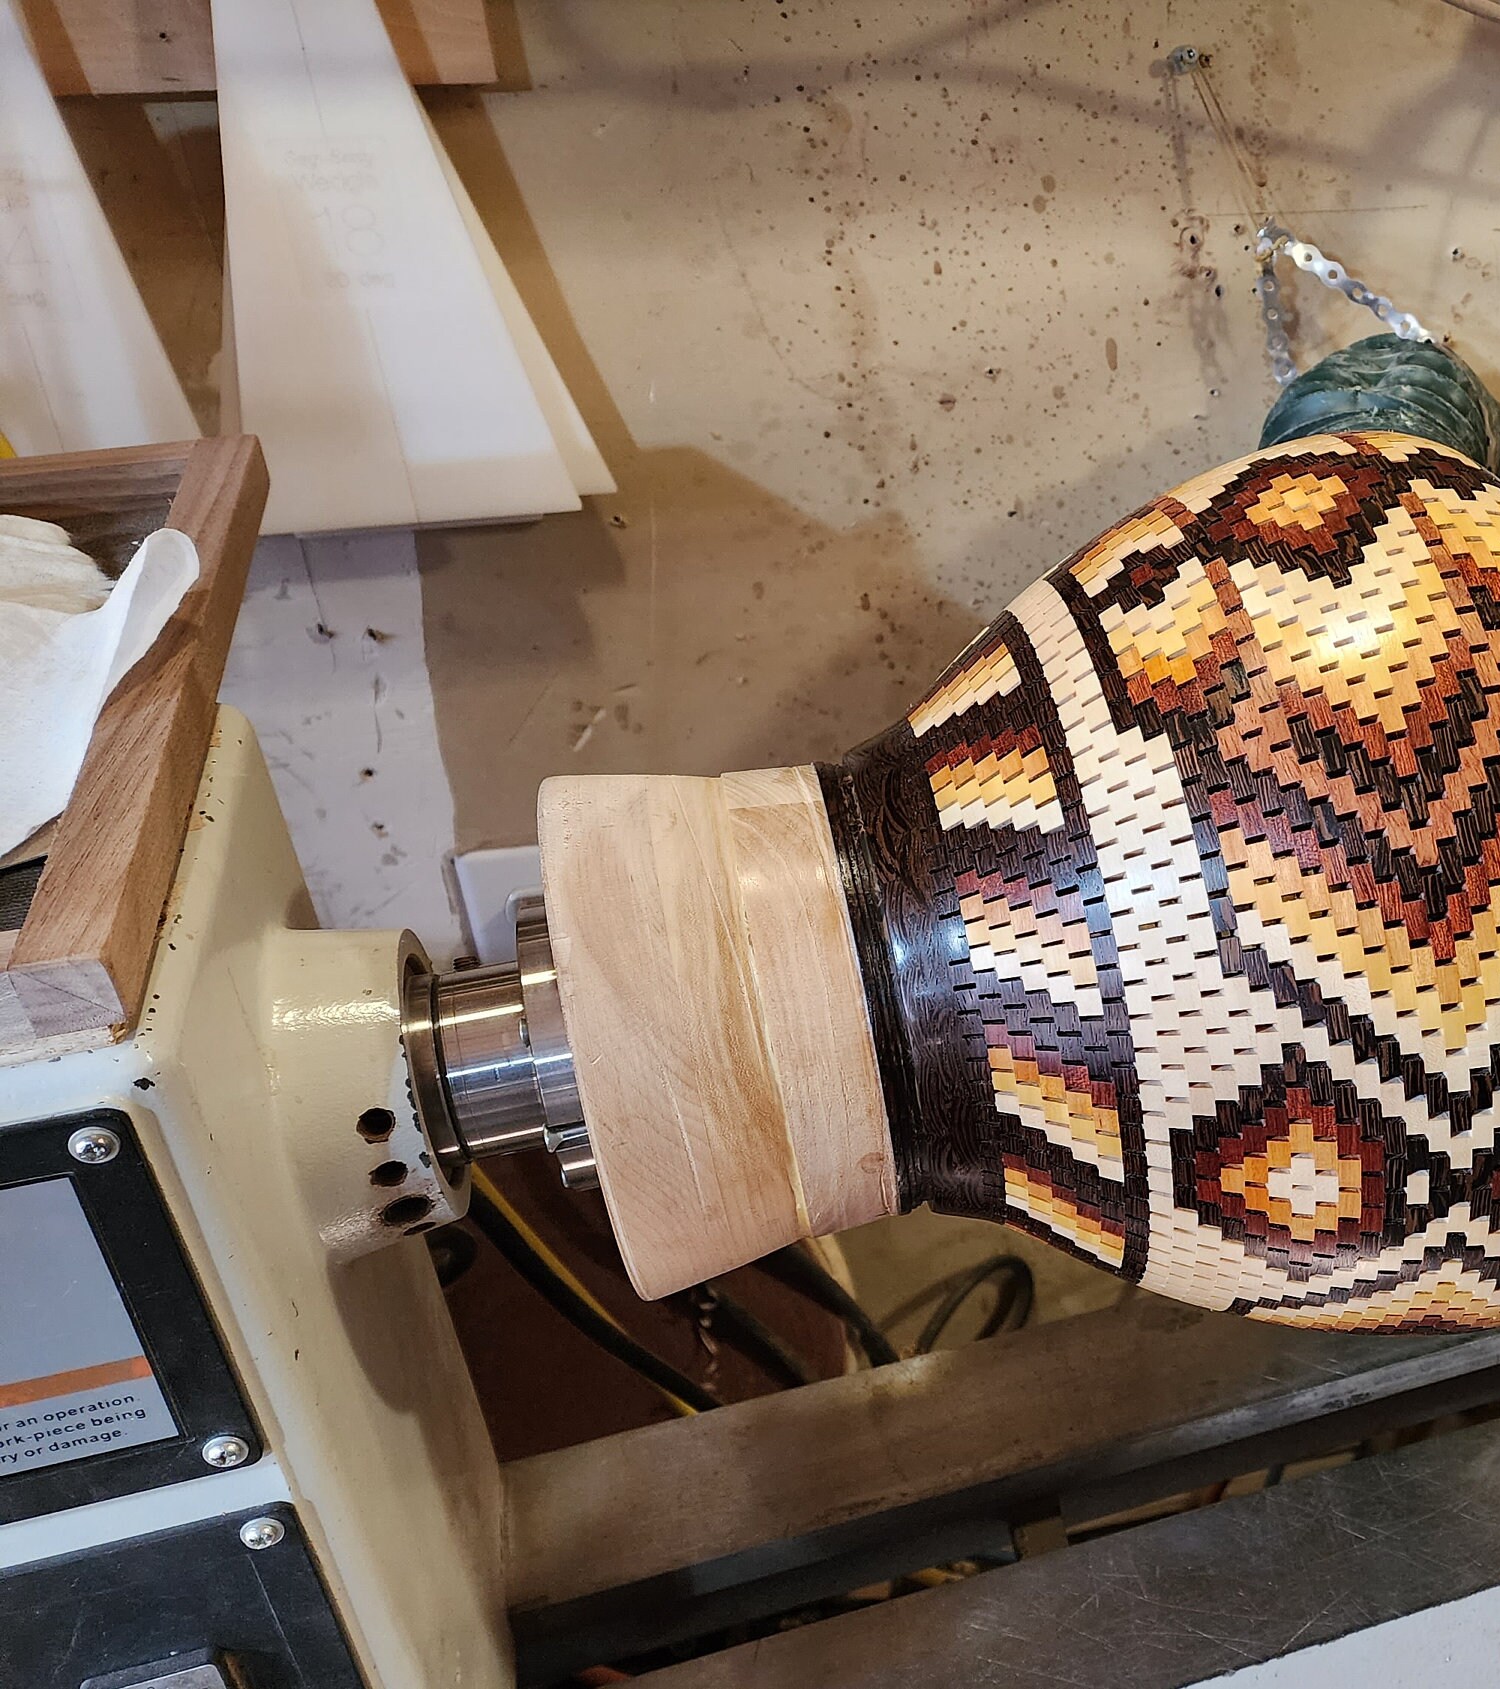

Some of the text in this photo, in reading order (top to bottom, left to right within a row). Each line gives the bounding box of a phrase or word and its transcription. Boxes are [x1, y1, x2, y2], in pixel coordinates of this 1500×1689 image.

[311, 204, 385, 257] 18
[0, 1423, 9, 1431] r
[16, 1417, 38, 1427] an
[91, 1408, 146, 1427] being
[24, 1447, 42, 1457] or
